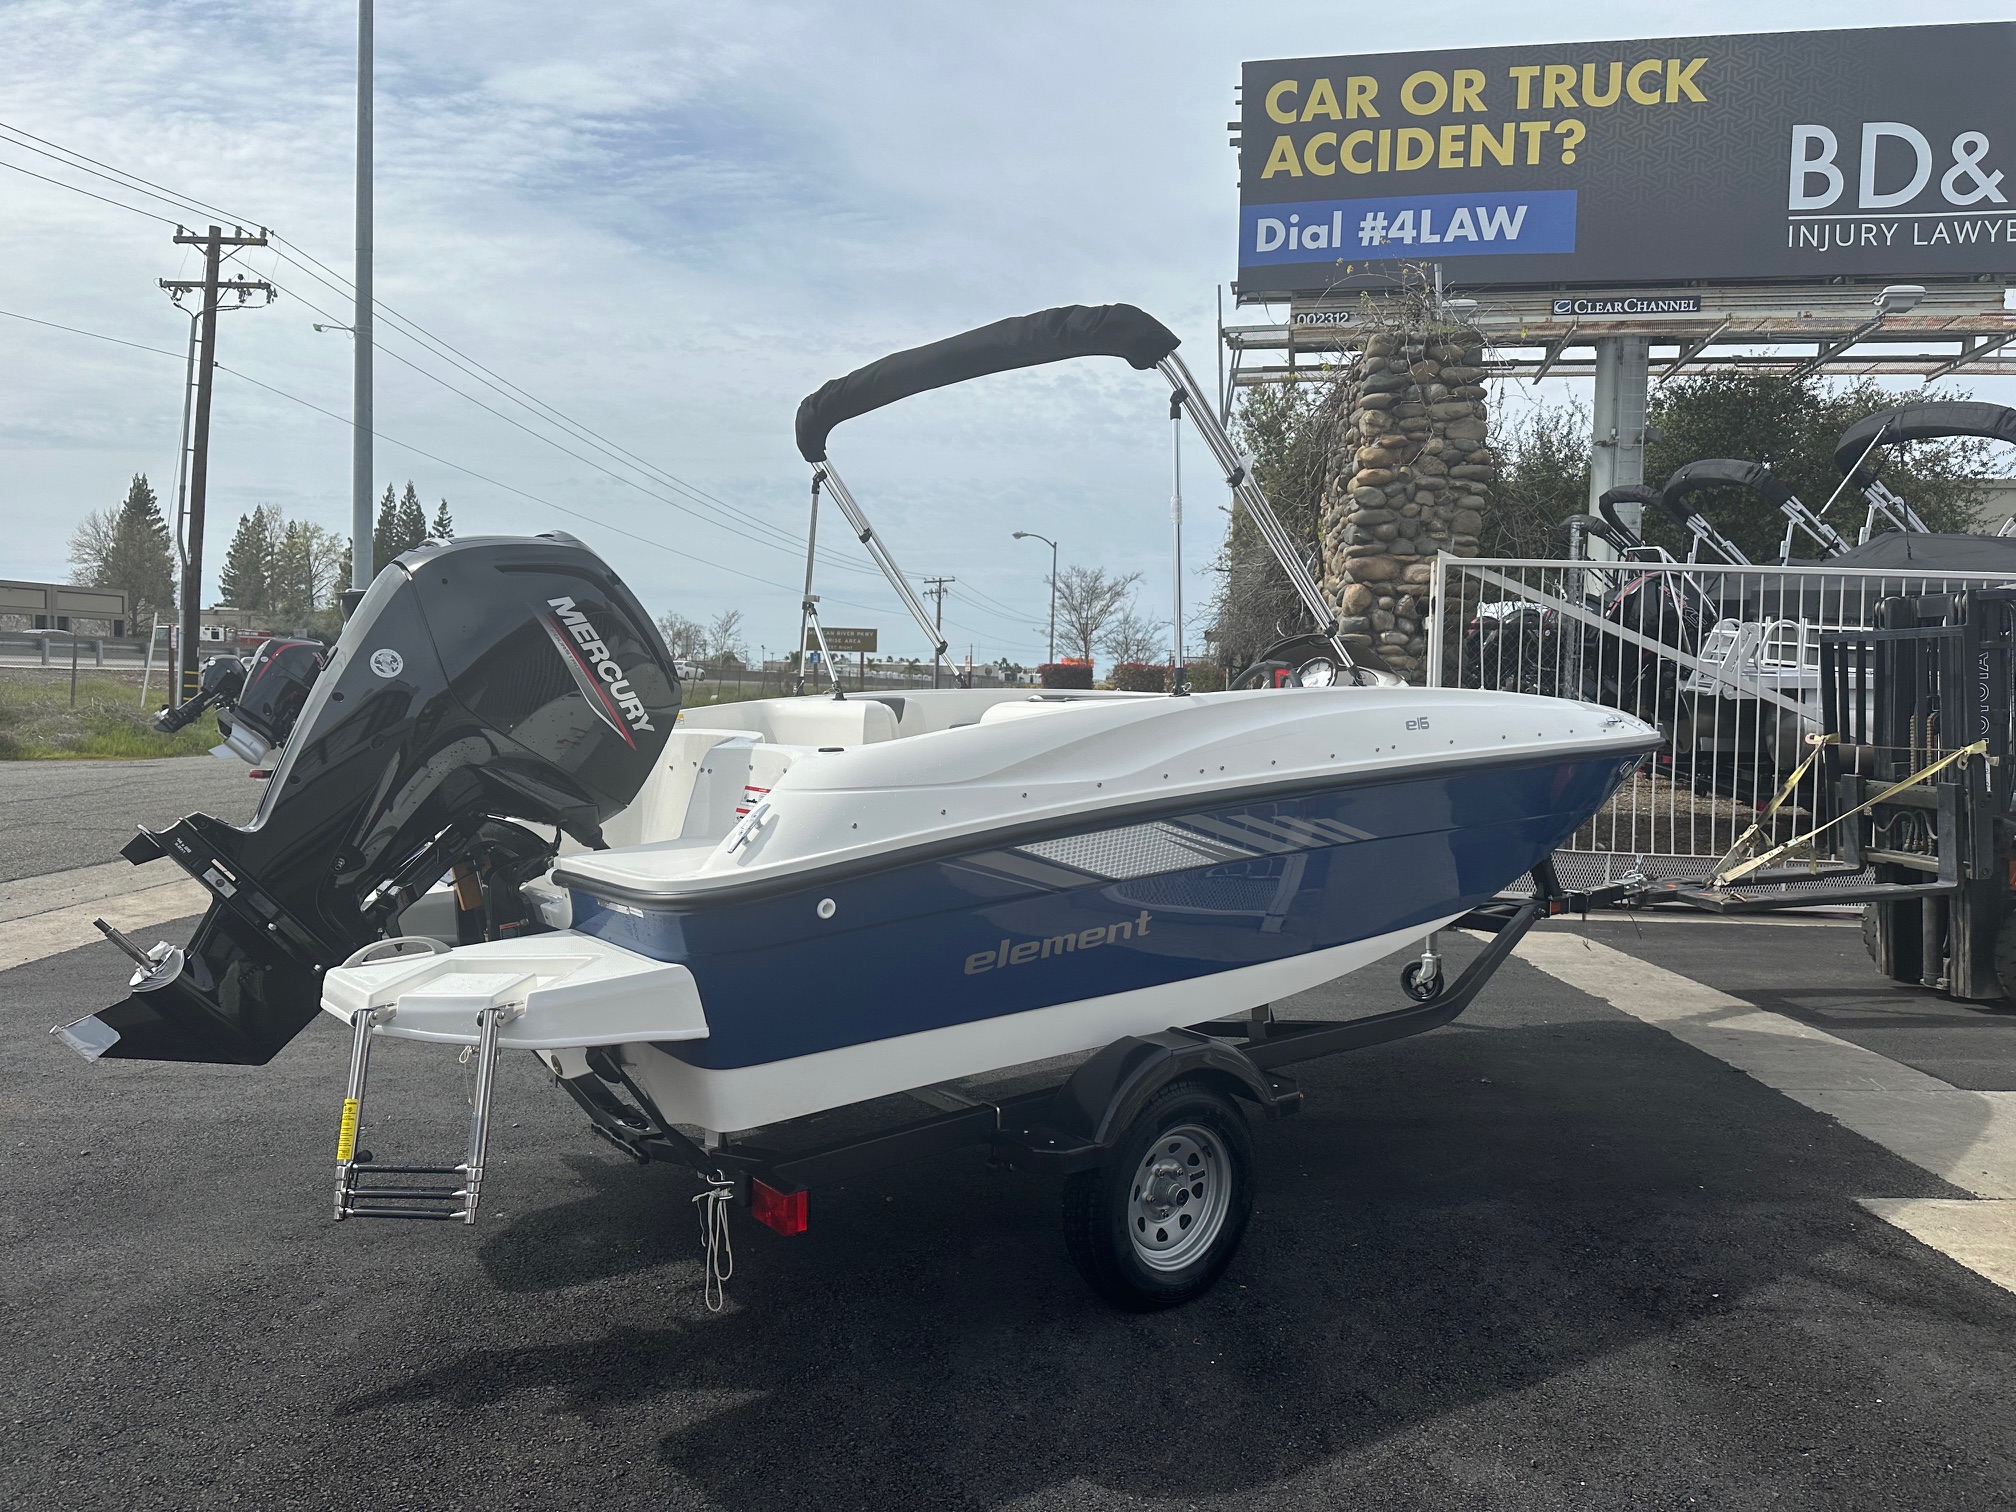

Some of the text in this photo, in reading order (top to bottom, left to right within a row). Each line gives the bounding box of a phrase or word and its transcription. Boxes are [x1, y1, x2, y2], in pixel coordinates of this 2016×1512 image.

[1265, 58, 1709, 124] CAR OR TRUCK
[1260, 119, 1587, 178] ACCIDENT?
[1788, 122, 2008, 210] BD&
[1256, 205, 1528, 252] Dial #4LAW
[1788, 223, 1898, 252] INJURY
[1297, 312, 1348, 324] 002312
[547, 596, 655, 732] MERCURY
[1405, 716, 1430, 731] e16
[963, 910, 1152, 975] element
